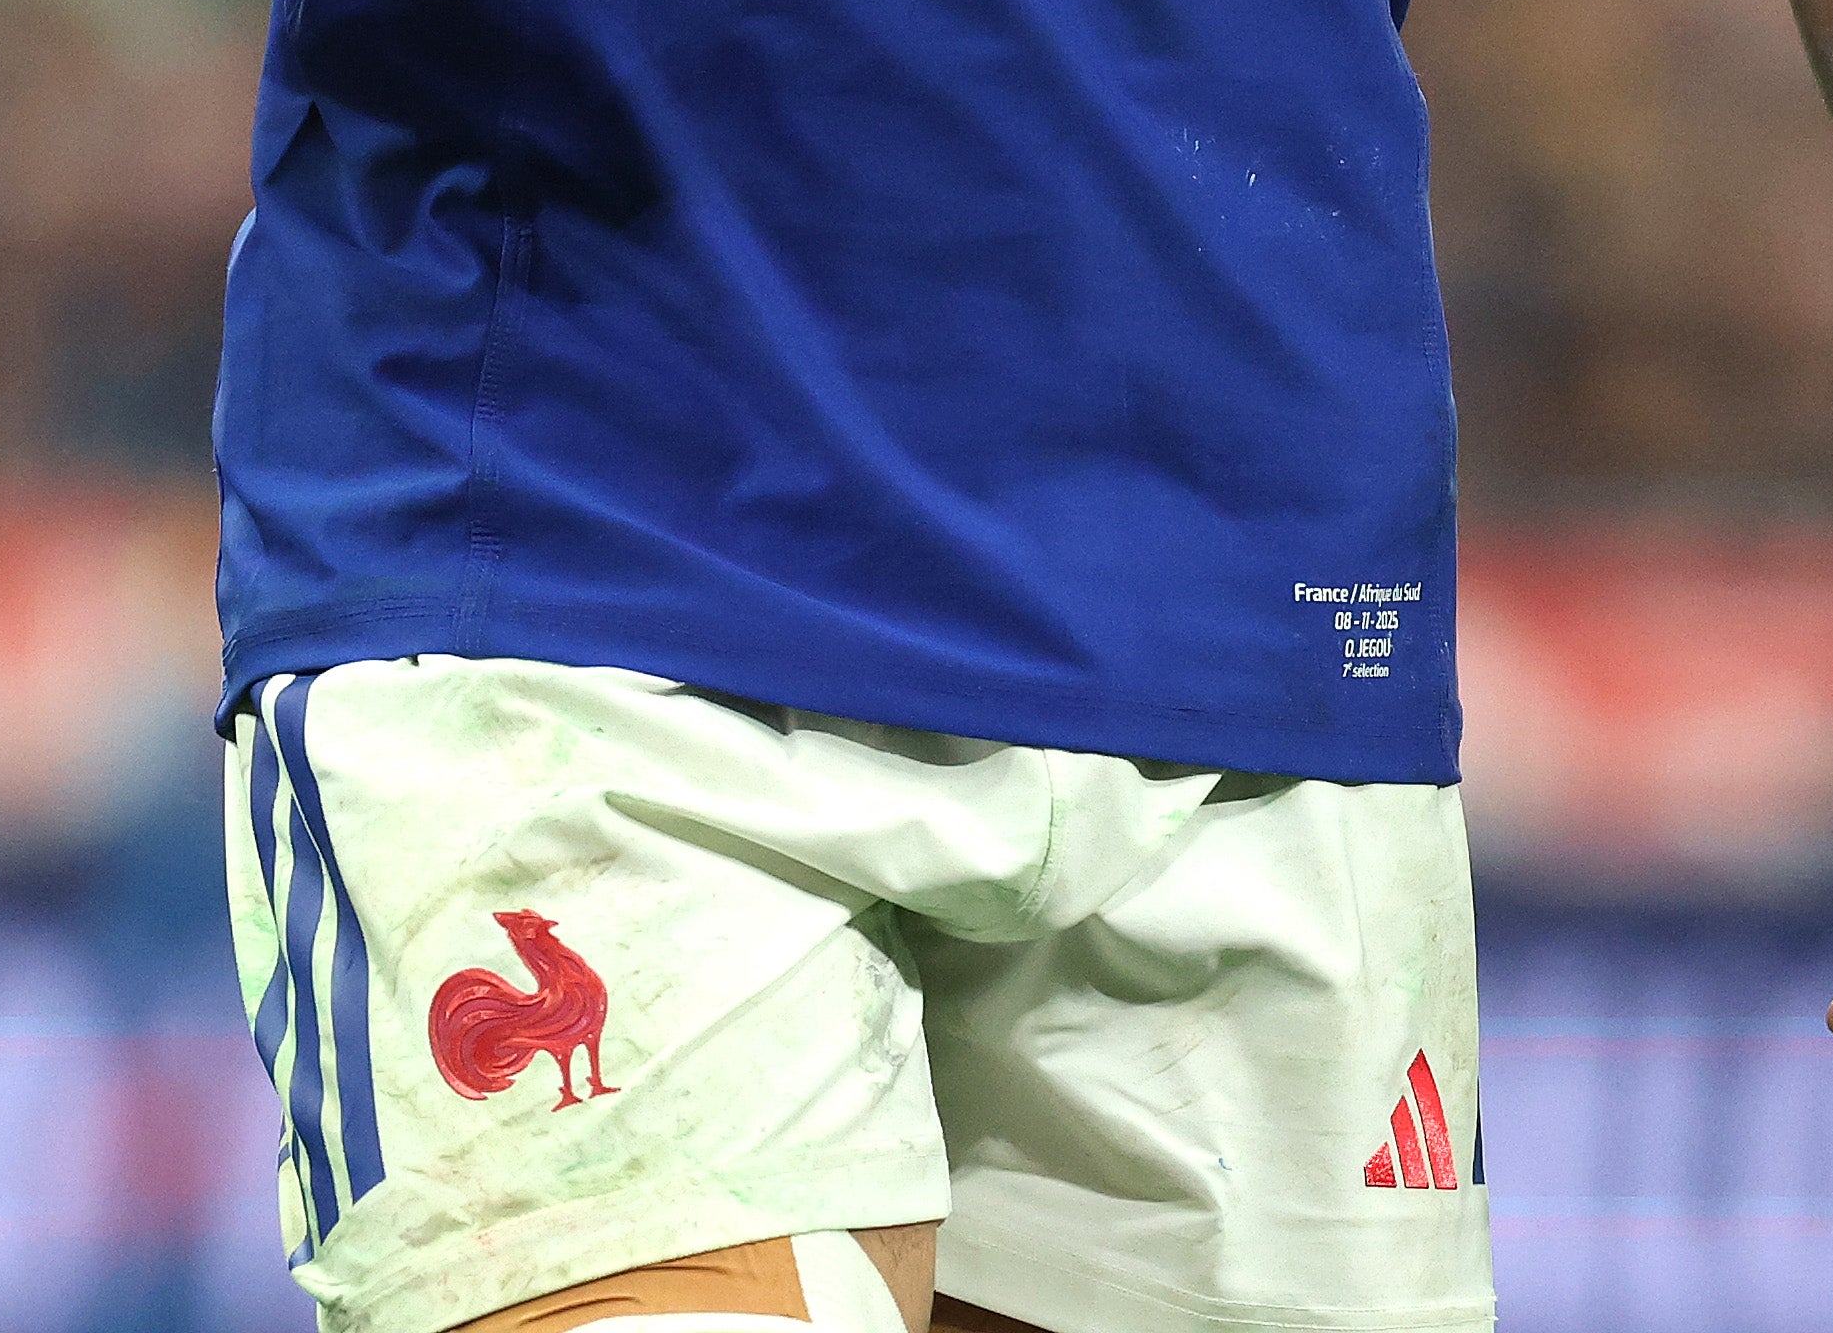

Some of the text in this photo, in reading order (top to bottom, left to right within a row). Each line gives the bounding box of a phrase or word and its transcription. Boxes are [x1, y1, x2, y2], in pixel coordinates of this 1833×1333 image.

[1294, 582, 1349, 602] France
[1358, 583, 1393, 608] Afrique
[1392, 583, 1403, 602] du
[1403, 582, 1421, 601] Sud
[1335, 612, 1352, 630] 08
[1375, 610, 1399, 630] 2025
[1345, 637, 1392, 658] O. JEGOU
[1352, 663, 1389, 678] sélection
